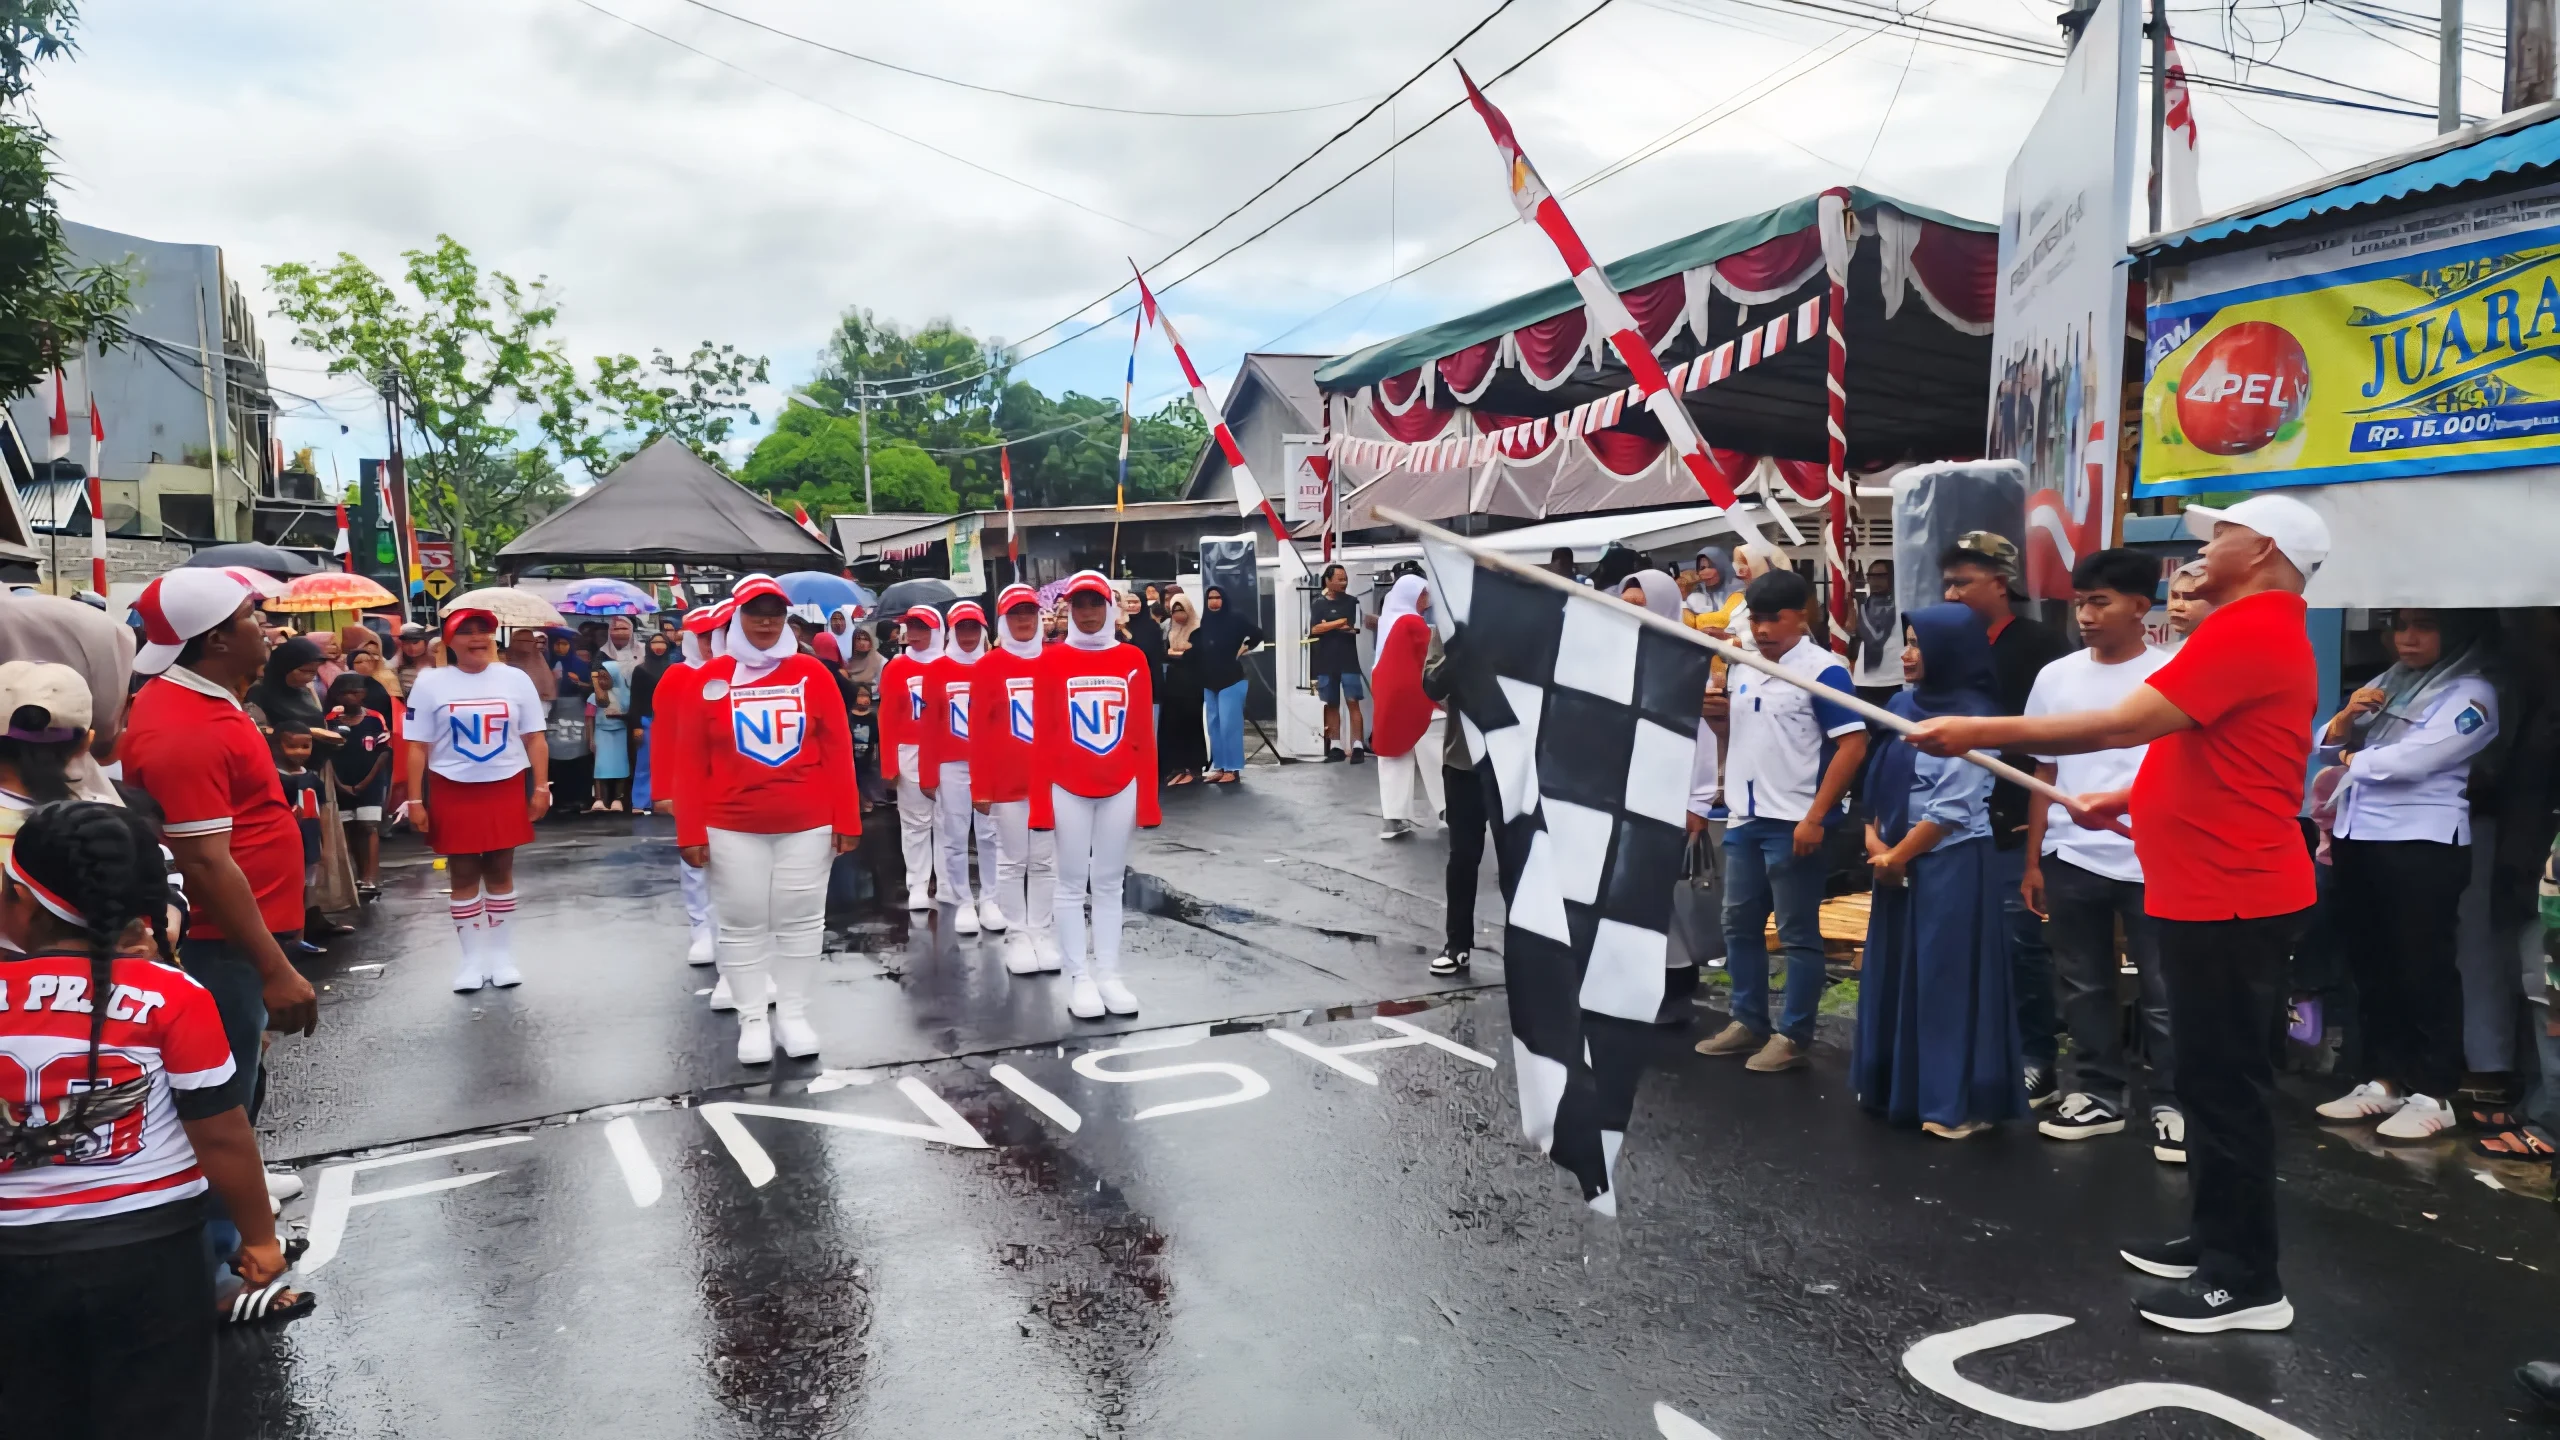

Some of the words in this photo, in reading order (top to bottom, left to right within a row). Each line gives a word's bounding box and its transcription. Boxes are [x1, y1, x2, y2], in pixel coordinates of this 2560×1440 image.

[2361, 275, 2560, 399] JUARA
[2367, 425, 2405, 448] Rp.
[299, 1014, 1497, 1276] FINISH
